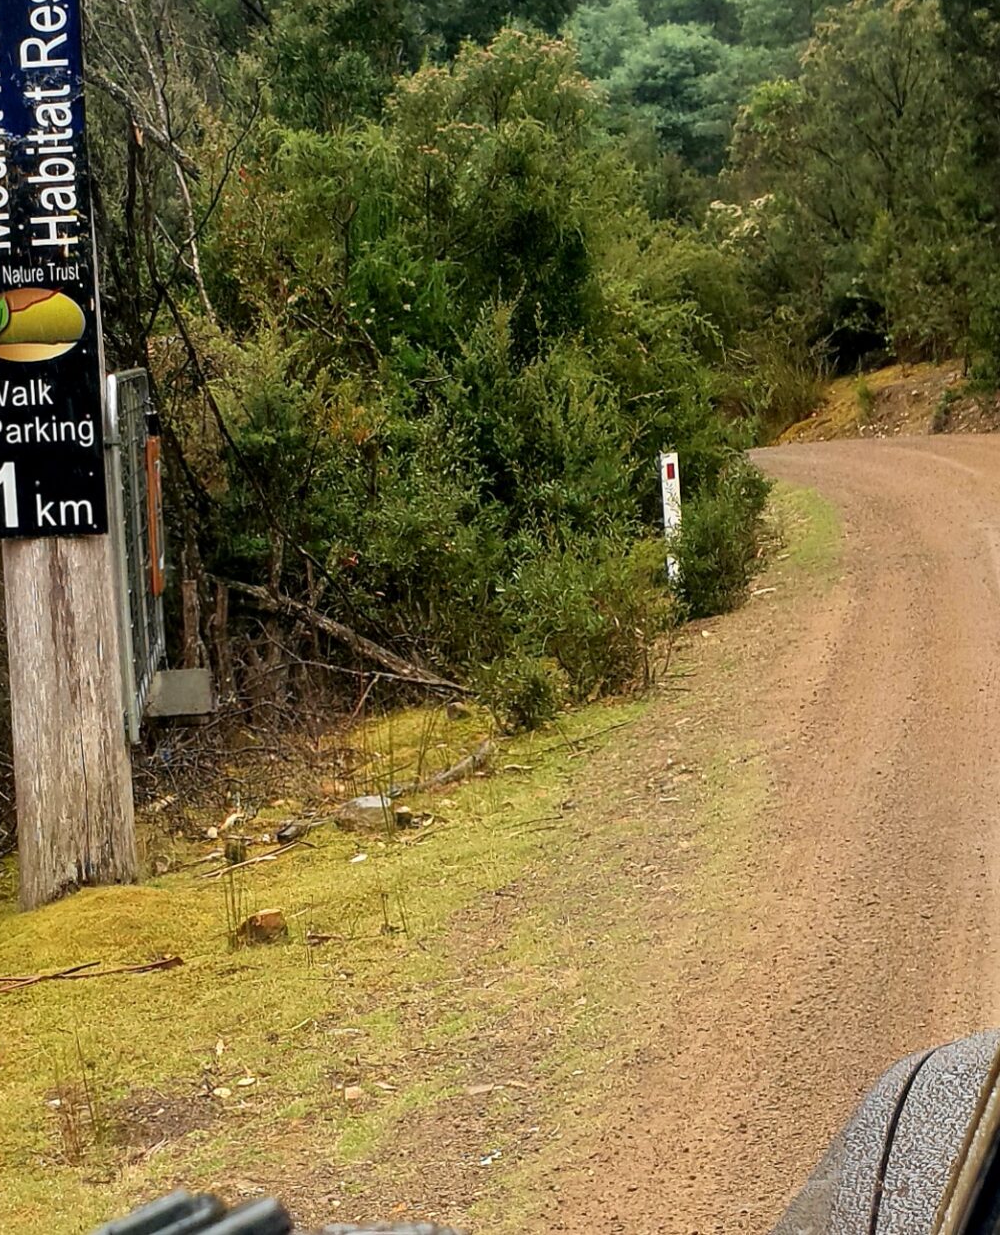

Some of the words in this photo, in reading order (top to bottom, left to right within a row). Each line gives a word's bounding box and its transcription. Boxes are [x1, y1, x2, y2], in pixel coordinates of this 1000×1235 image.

[23, 84, 79, 247] Habitat
[3, 265, 44, 284] Nature
[47, 263, 80, 282] Trust
[35, 493, 94, 527] km
